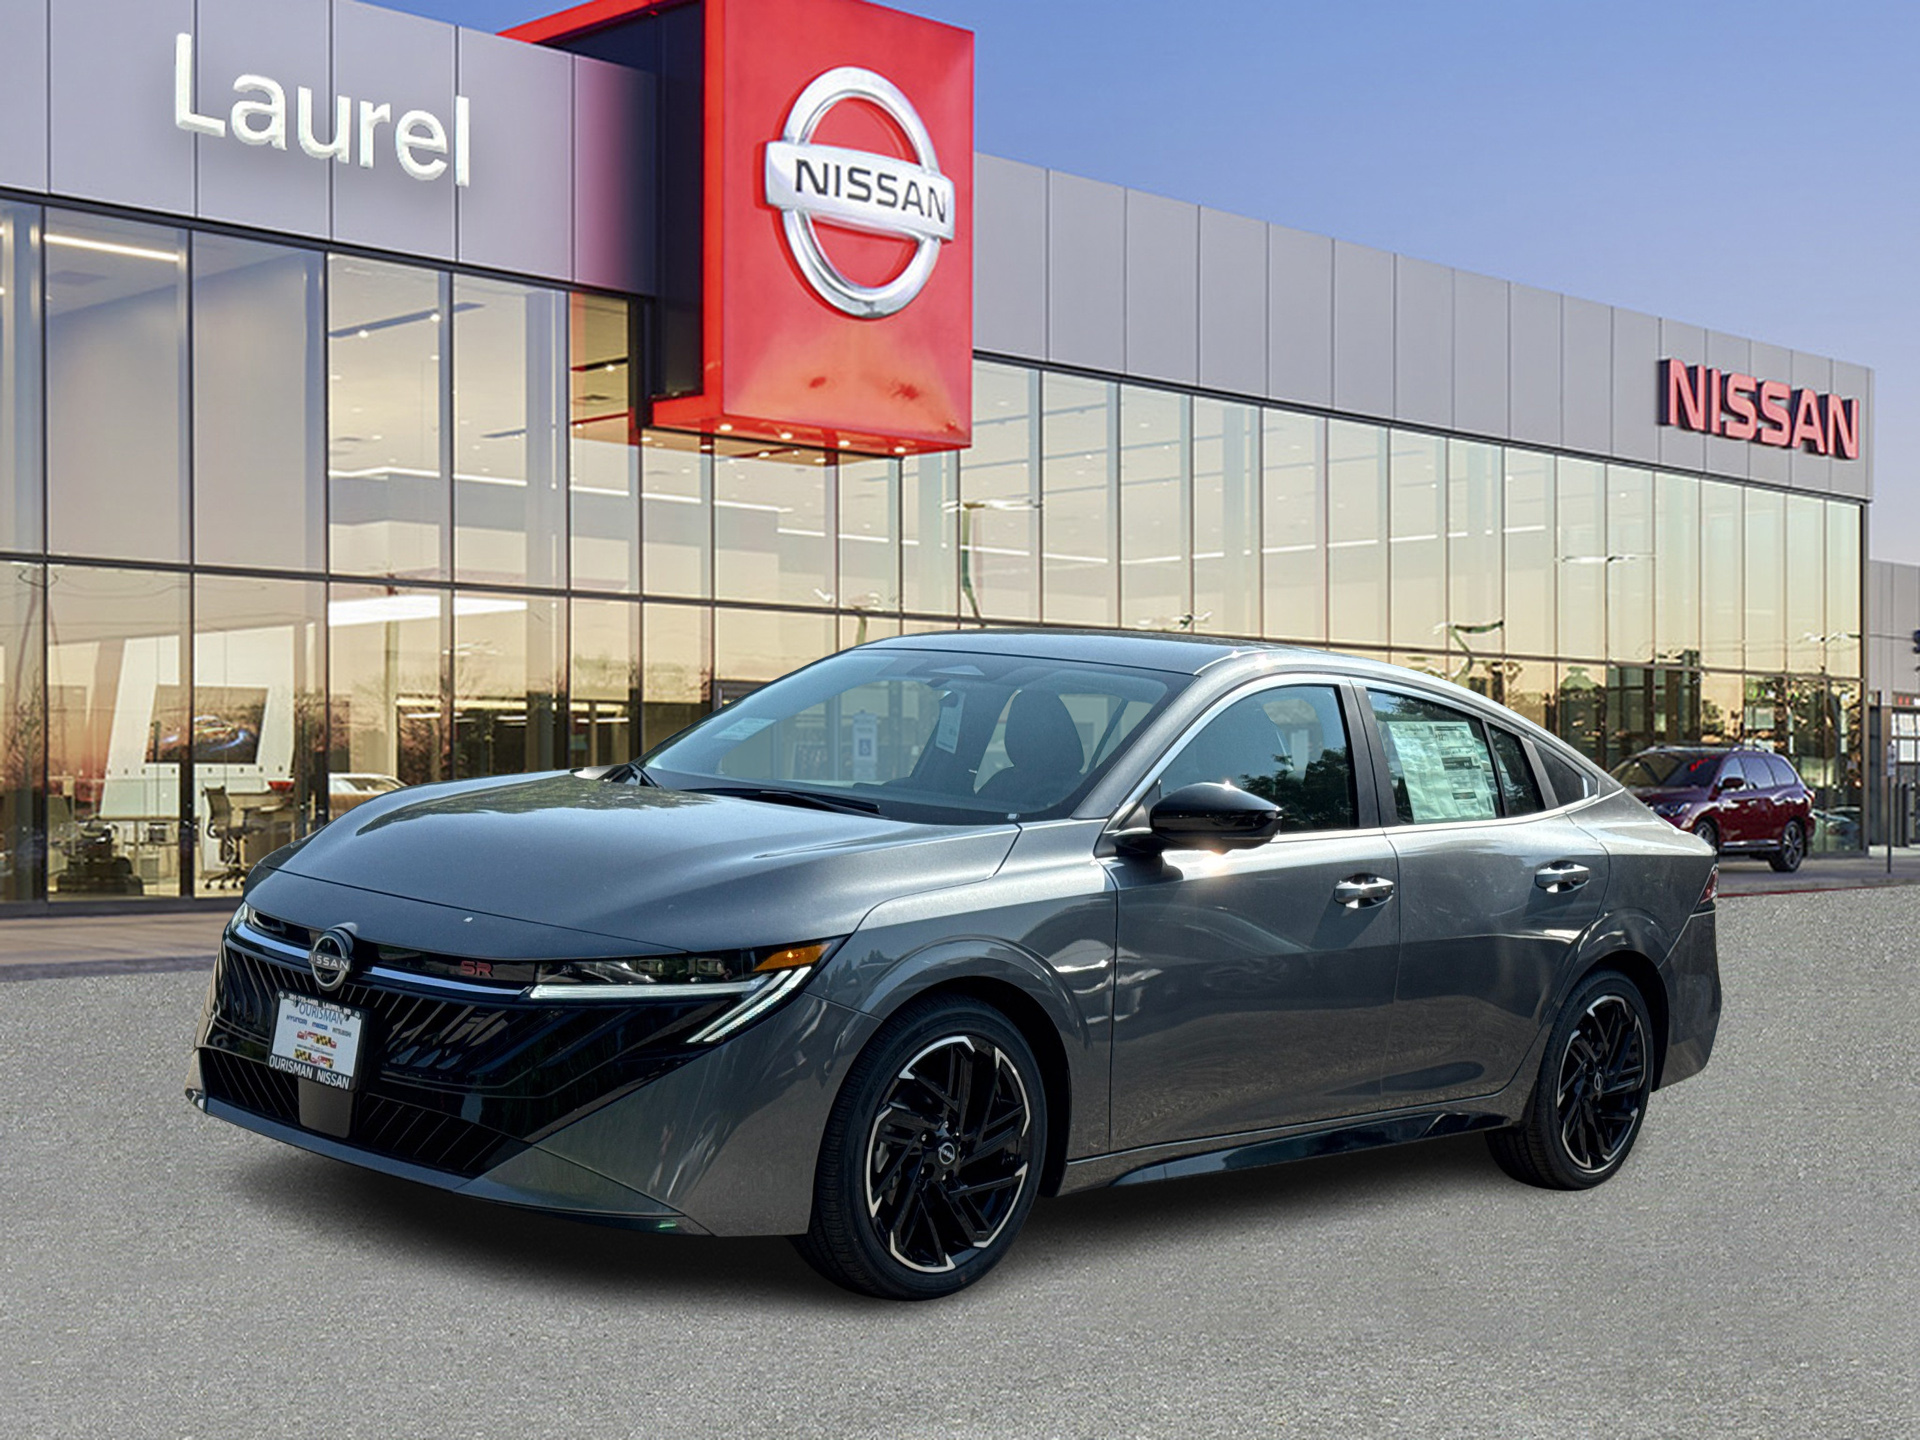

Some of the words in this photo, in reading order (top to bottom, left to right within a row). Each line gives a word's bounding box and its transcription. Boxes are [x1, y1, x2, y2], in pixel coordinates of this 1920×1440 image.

[174, 32, 470, 187] Laurel
[795, 158, 946, 223] NISSAN
[1660, 357, 1860, 460] NISSAN
[461, 960, 491, 977] SR
[299, 1003, 344, 1025] OURISMAN
[269, 1054, 314, 1079] OURISMAN
[316, 1069, 350, 1090] NISSAN
